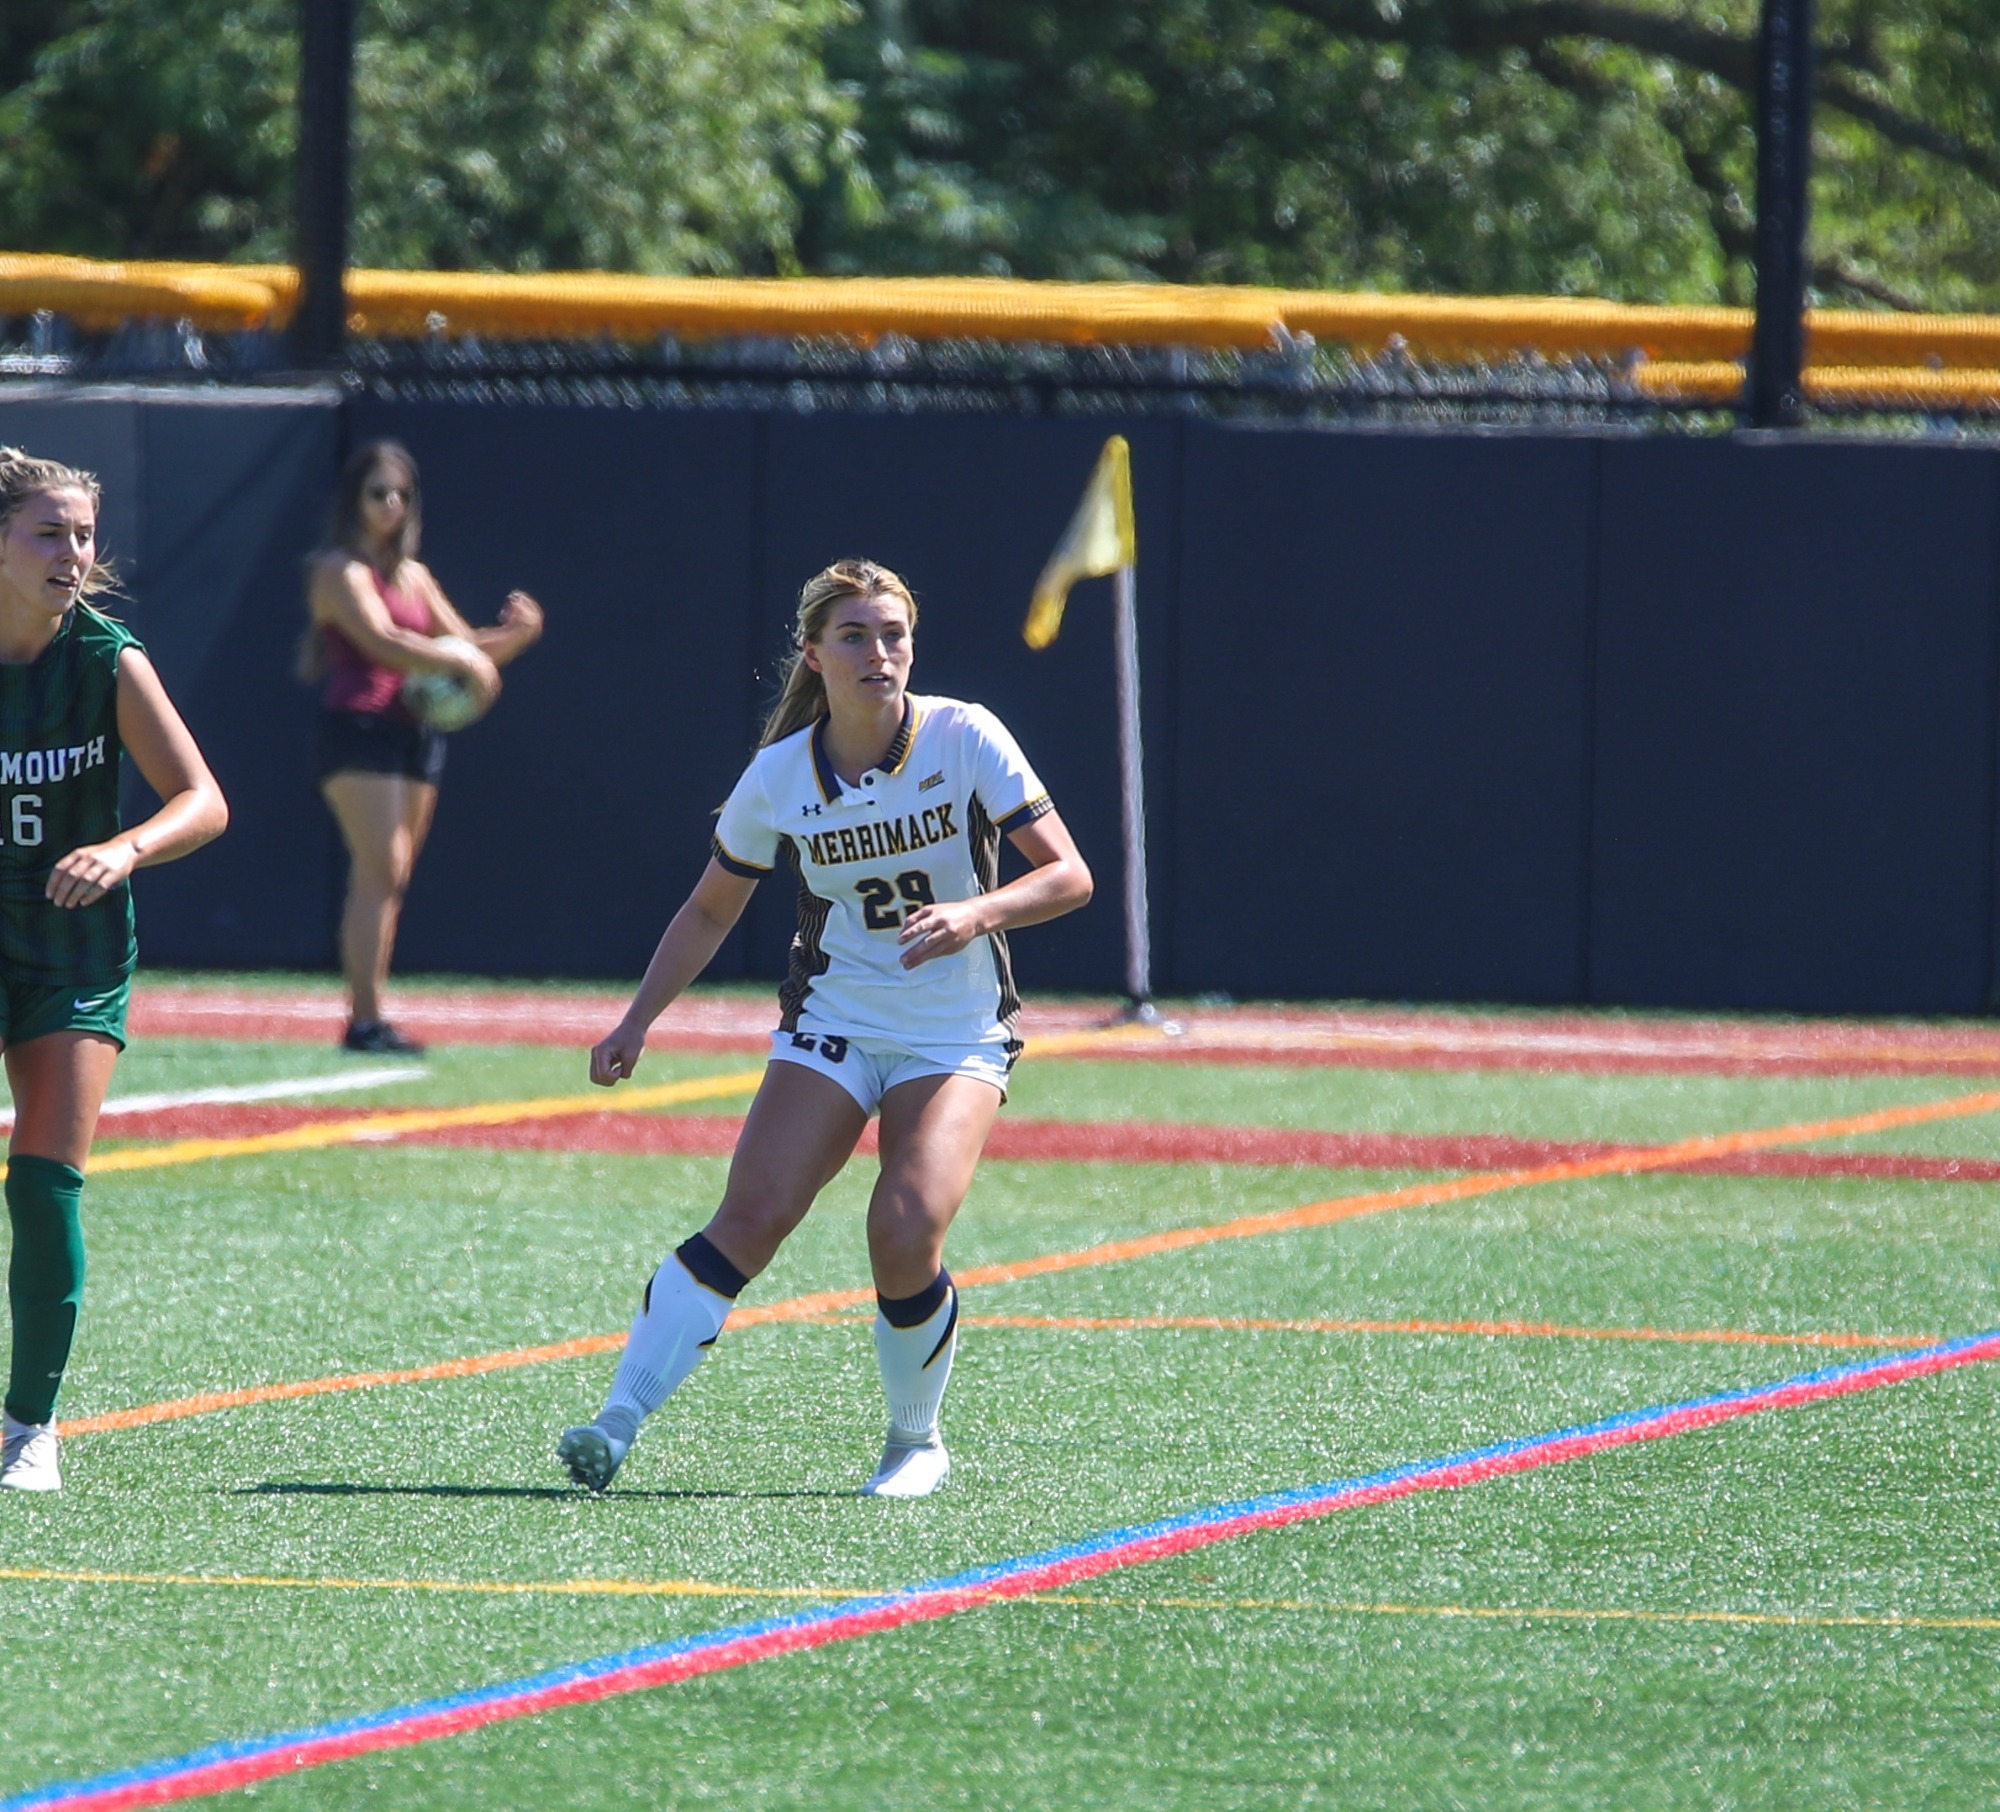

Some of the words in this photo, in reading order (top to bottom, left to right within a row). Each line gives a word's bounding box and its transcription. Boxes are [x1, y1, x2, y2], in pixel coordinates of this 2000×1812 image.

[0, 794, 42, 846] 6
[801, 802, 958, 866] MERRIMACK
[854, 869, 936, 930] 29
